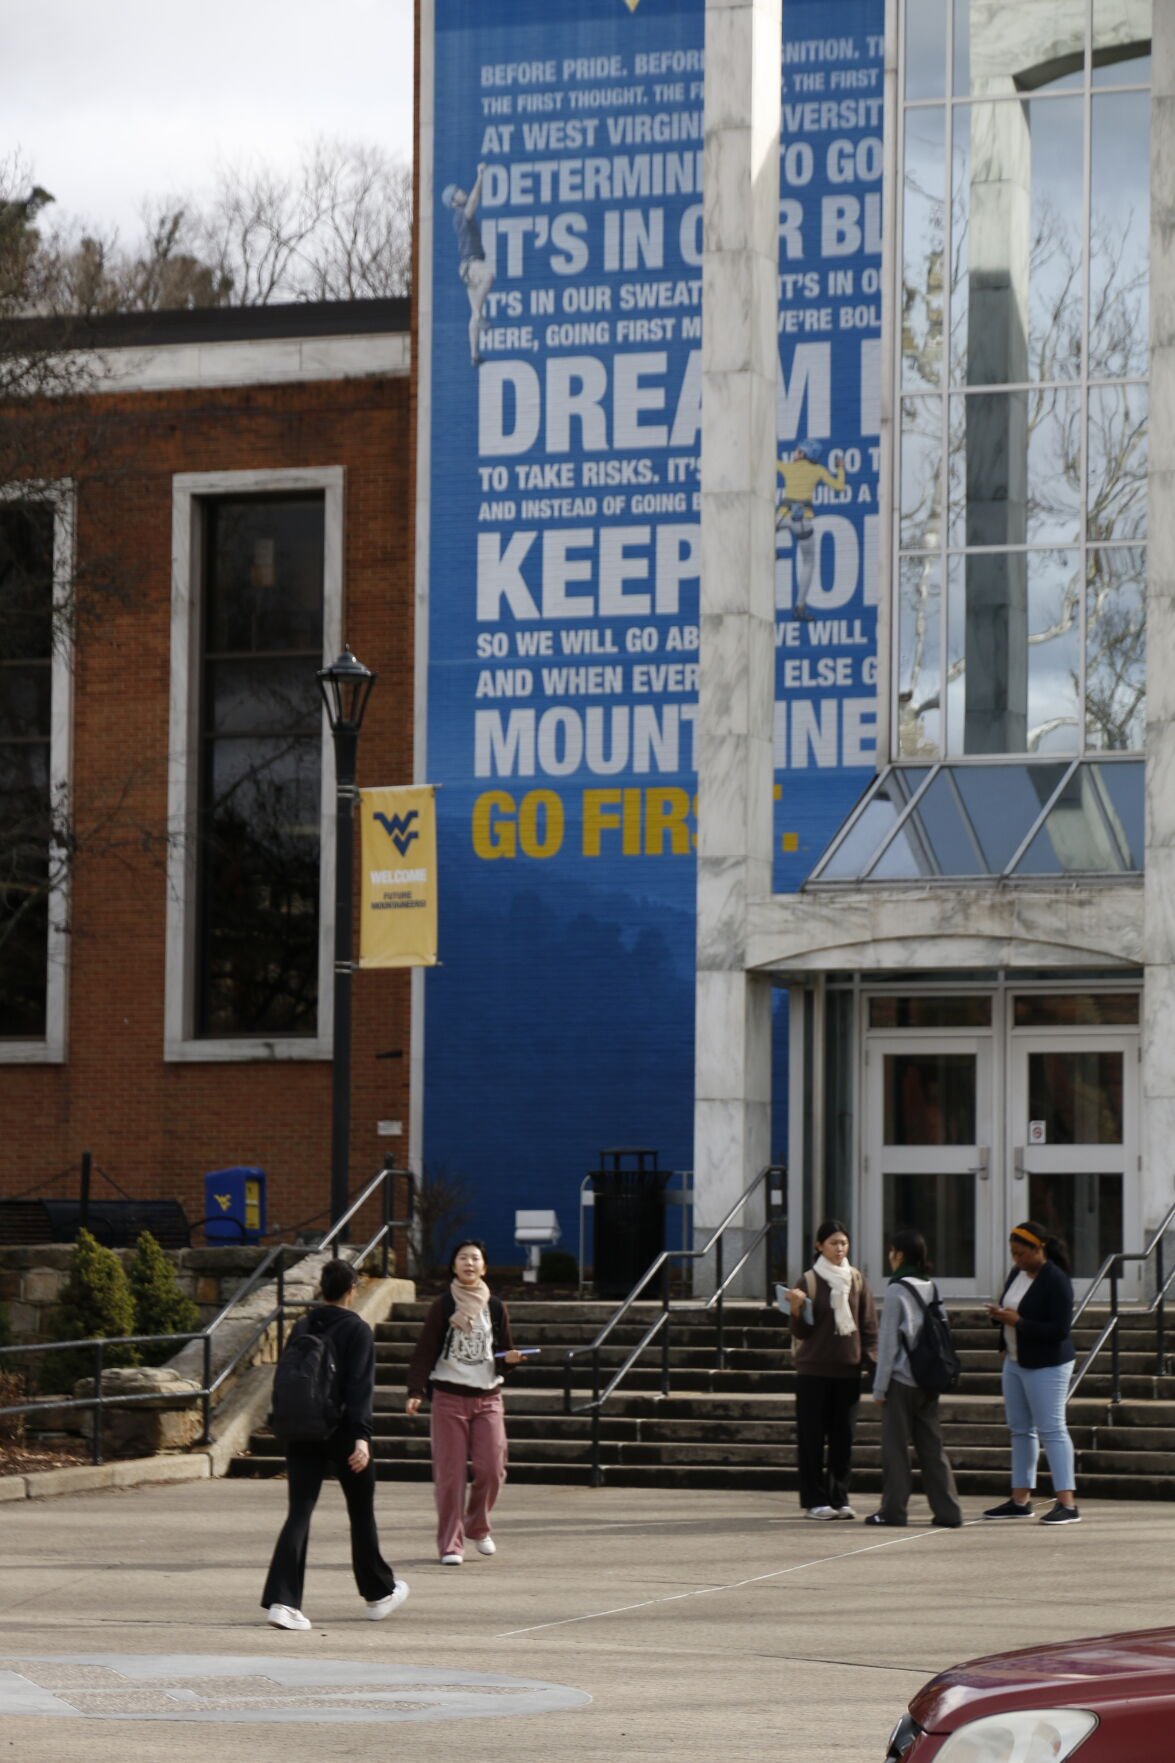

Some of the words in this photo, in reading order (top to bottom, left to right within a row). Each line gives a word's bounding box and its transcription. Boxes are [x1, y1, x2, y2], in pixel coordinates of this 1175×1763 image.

[481, 60, 556, 87] BEFORE
[563, 56, 627, 81] PRIDE.
[782, 36, 859, 64] NITION.
[482, 96, 512, 115] THE
[518, 92, 563, 113] FIRST
[569, 86, 647, 109] THOUGHT.
[653, 82, 684, 102] THE
[793, 72, 825, 92] THE
[831, 68, 879, 90] FIRST
[481, 124, 515, 154] AT
[523, 118, 599, 151] WEST
[826, 137, 883, 184] GO
[481, 212, 589, 279] IT'S
[604, 207, 664, 272] IN
[530, 289, 555, 316] IN
[562, 285, 611, 313] OUR
[828, 269, 853, 297] IN
[479, 326, 539, 353] HERE,
[546, 320, 609, 347] GOING
[616, 318, 675, 343] FIRST
[478, 465, 508, 493] TO
[515, 463, 574, 491] TAKE
[581, 457, 660, 488] RISKS.
[478, 501, 516, 522] AND
[521, 496, 597, 520] INSTEAD
[603, 495, 626, 516] OF
[631, 492, 686, 515] GOING
[476, 523, 701, 622] KEEP
[476, 632, 509, 658] SO
[516, 631, 553, 657] WE
[560, 629, 619, 655] WILL
[626, 627, 659, 653] GO
[808, 619, 868, 646] WILL
[475, 668, 534, 699] AND
[542, 666, 623, 696] WHEN
[784, 657, 853, 688] ELSE
[471, 788, 565, 860] GO
